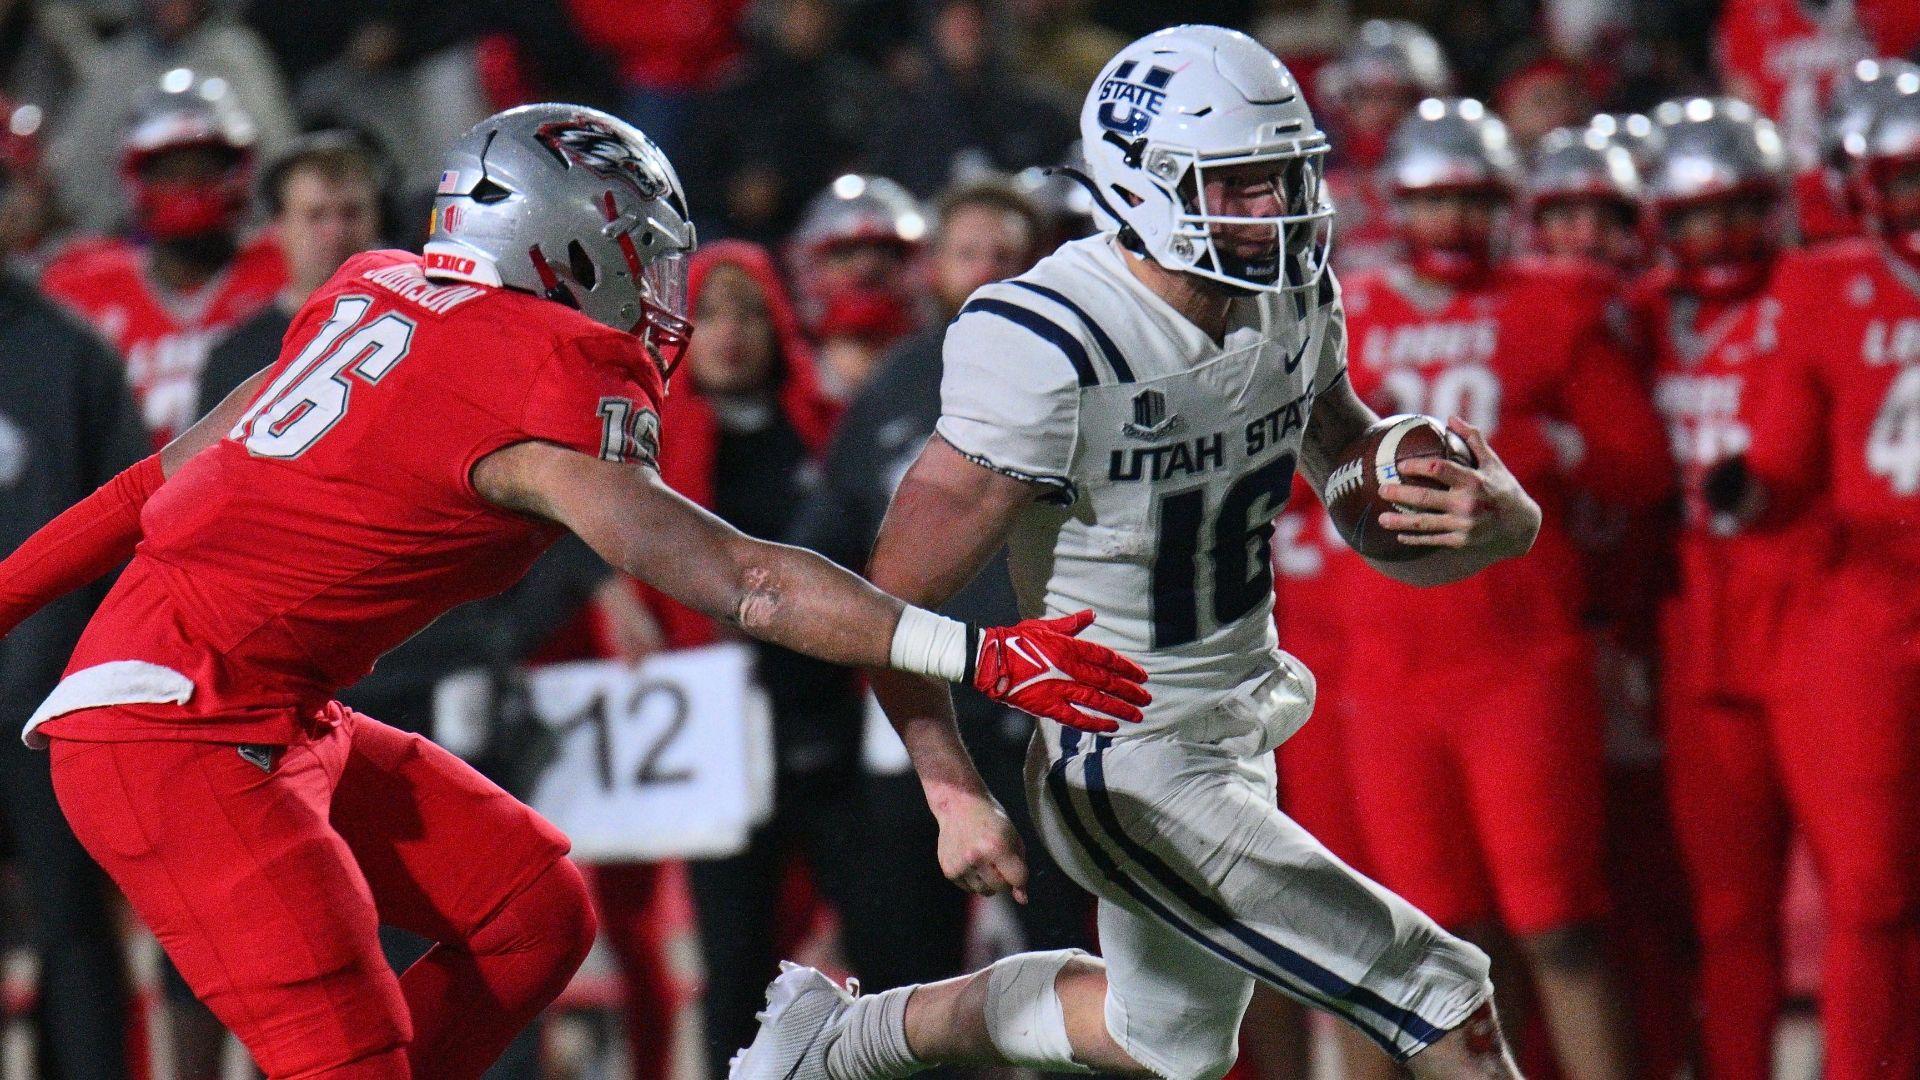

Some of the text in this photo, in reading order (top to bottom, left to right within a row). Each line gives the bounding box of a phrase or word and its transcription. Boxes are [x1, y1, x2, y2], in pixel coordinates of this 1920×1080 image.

[1099, 80, 1167, 115] STATE
[228, 294, 417, 461] 16
[1109, 433, 1223, 481] UTAH
[1246, 392, 1313, 456] STA
[1151, 452, 1297, 650] 16
[555, 678, 698, 791] 12
